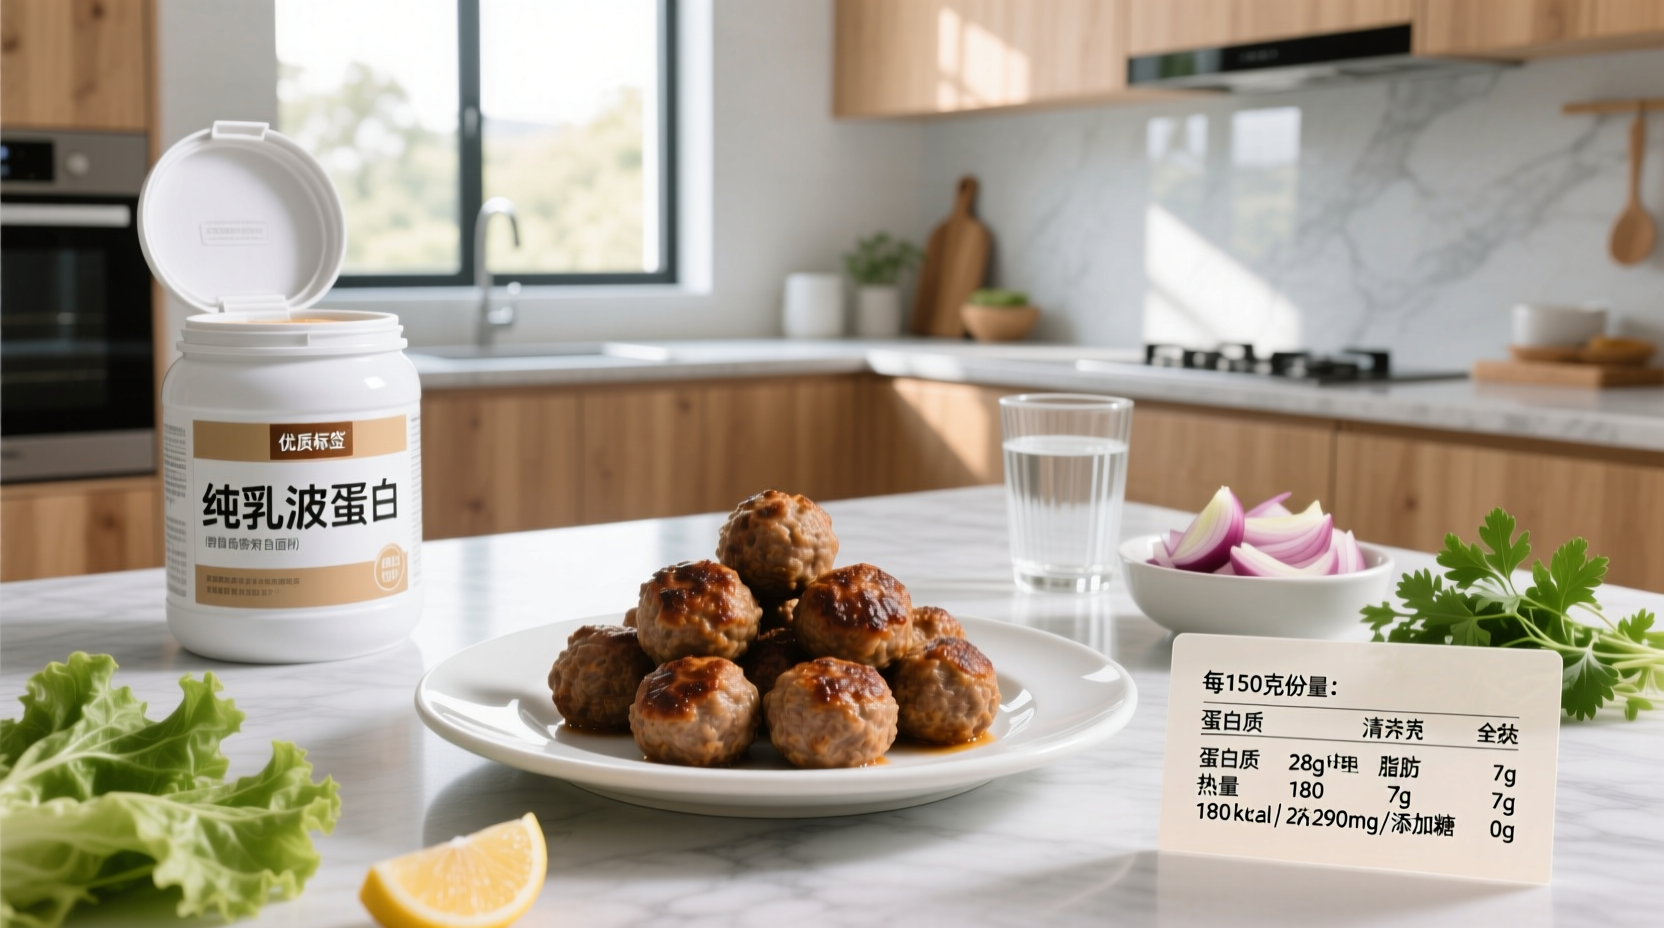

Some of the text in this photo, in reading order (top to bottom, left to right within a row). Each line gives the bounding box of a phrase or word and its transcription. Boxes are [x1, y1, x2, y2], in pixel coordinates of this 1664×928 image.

[203, 478, 398, 530] 纯乳波蛋白
[1200, 709, 1264, 733] 蛋白质
[1199, 746, 1261, 770] 蛋白质
[1377, 755, 1422, 779] 脂肪
[1493, 764, 1517, 788] 7g
[1196, 772, 1516, 817] 热量 180 7g 7g
[1489, 819, 1515, 844] 0g
